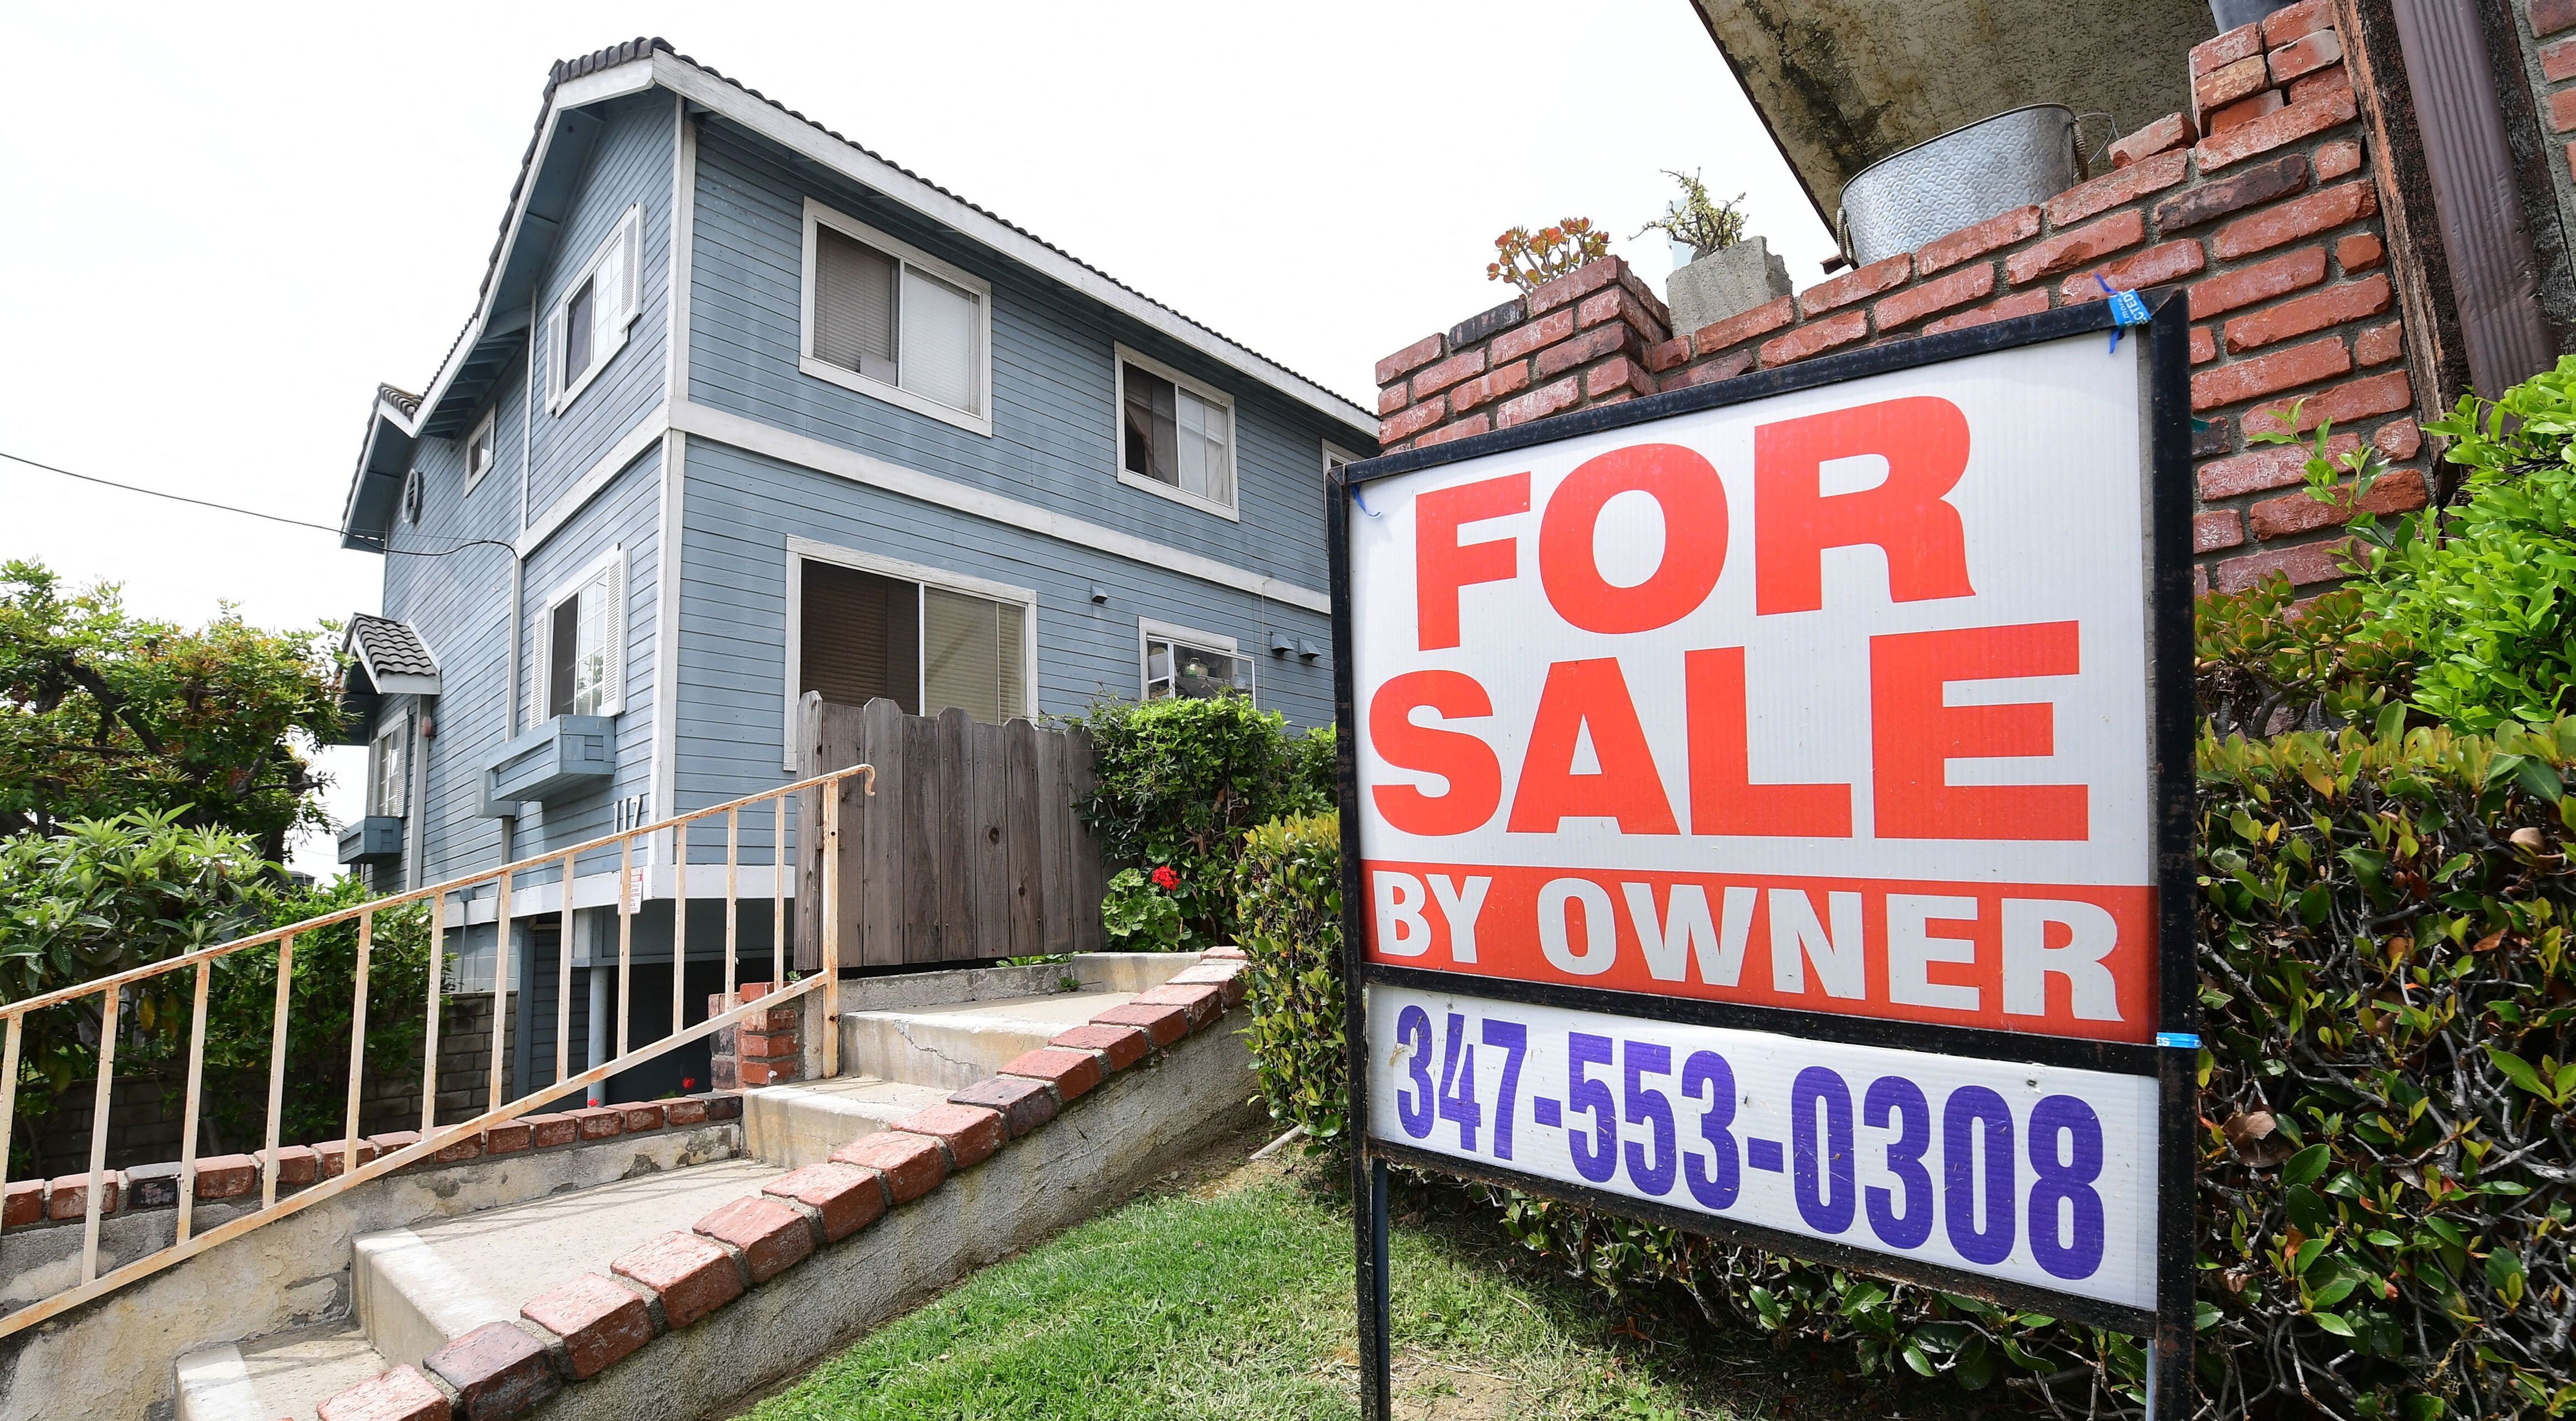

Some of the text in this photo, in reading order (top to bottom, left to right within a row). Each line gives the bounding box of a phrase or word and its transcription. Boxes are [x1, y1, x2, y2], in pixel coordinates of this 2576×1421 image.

[1416, 396, 1976, 651] FOR
[613, 794, 641, 833] 117
[1370, 621, 2088, 841] SALE
[1372, 871, 2124, 1022] BY OWNER
[1396, 1004, 2105, 1281] 347-553-0308
